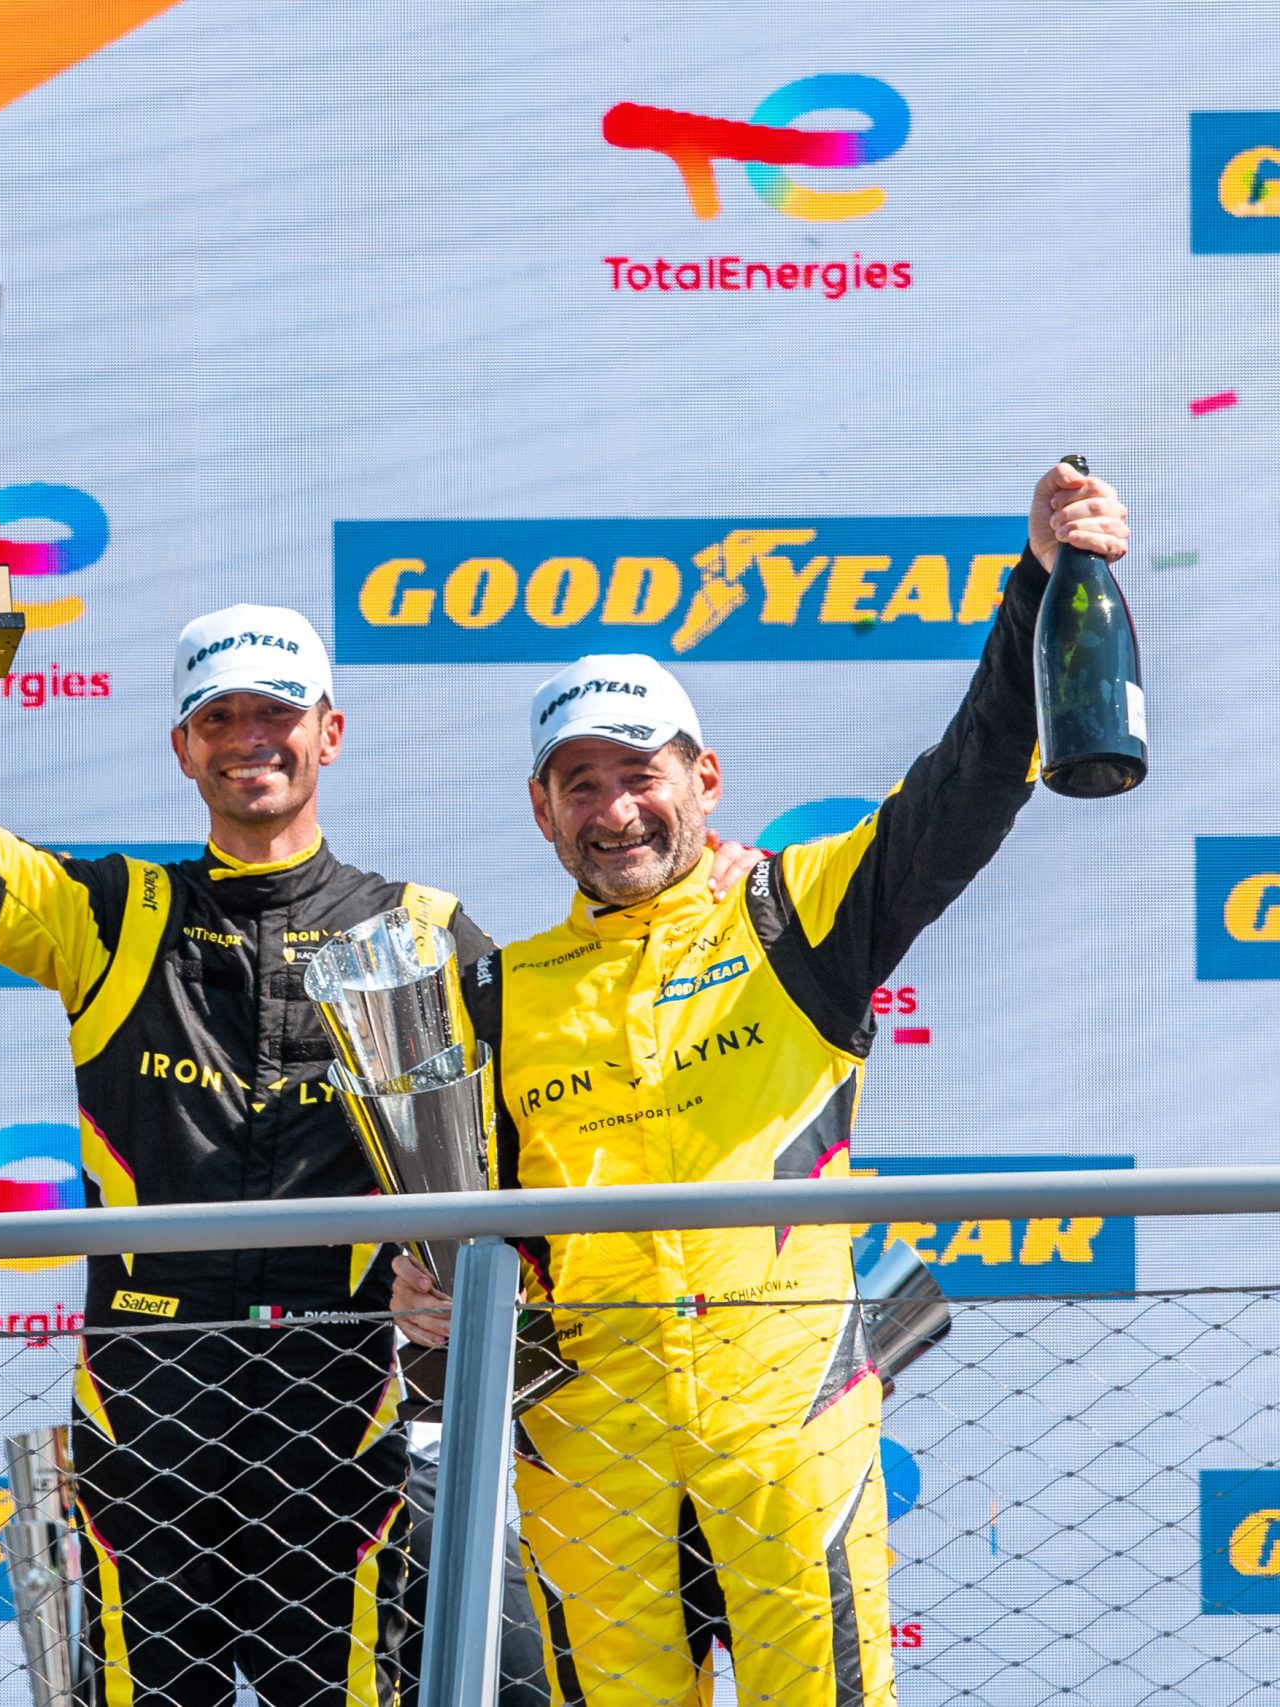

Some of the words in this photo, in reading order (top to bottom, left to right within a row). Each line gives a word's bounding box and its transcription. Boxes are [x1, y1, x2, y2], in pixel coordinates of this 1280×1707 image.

[602, 252, 911, 299] TotalEnergies
[142, 867, 159, 912] Sabelt
[283, 930, 320, 943] IRON
[140, 1051, 222, 1093] IRON
[520, 1070, 592, 1118] IRON
[674, 1022, 764, 1071] LYNX
[579, 1108, 672, 1134] MOTORSPORT
[677, 1095, 703, 1113] LAB
[118, 1293, 171, 1315] Sabelt
[724, 1281, 781, 1304] SCHIAVONI
[785, 1279, 799, 1290] A+
